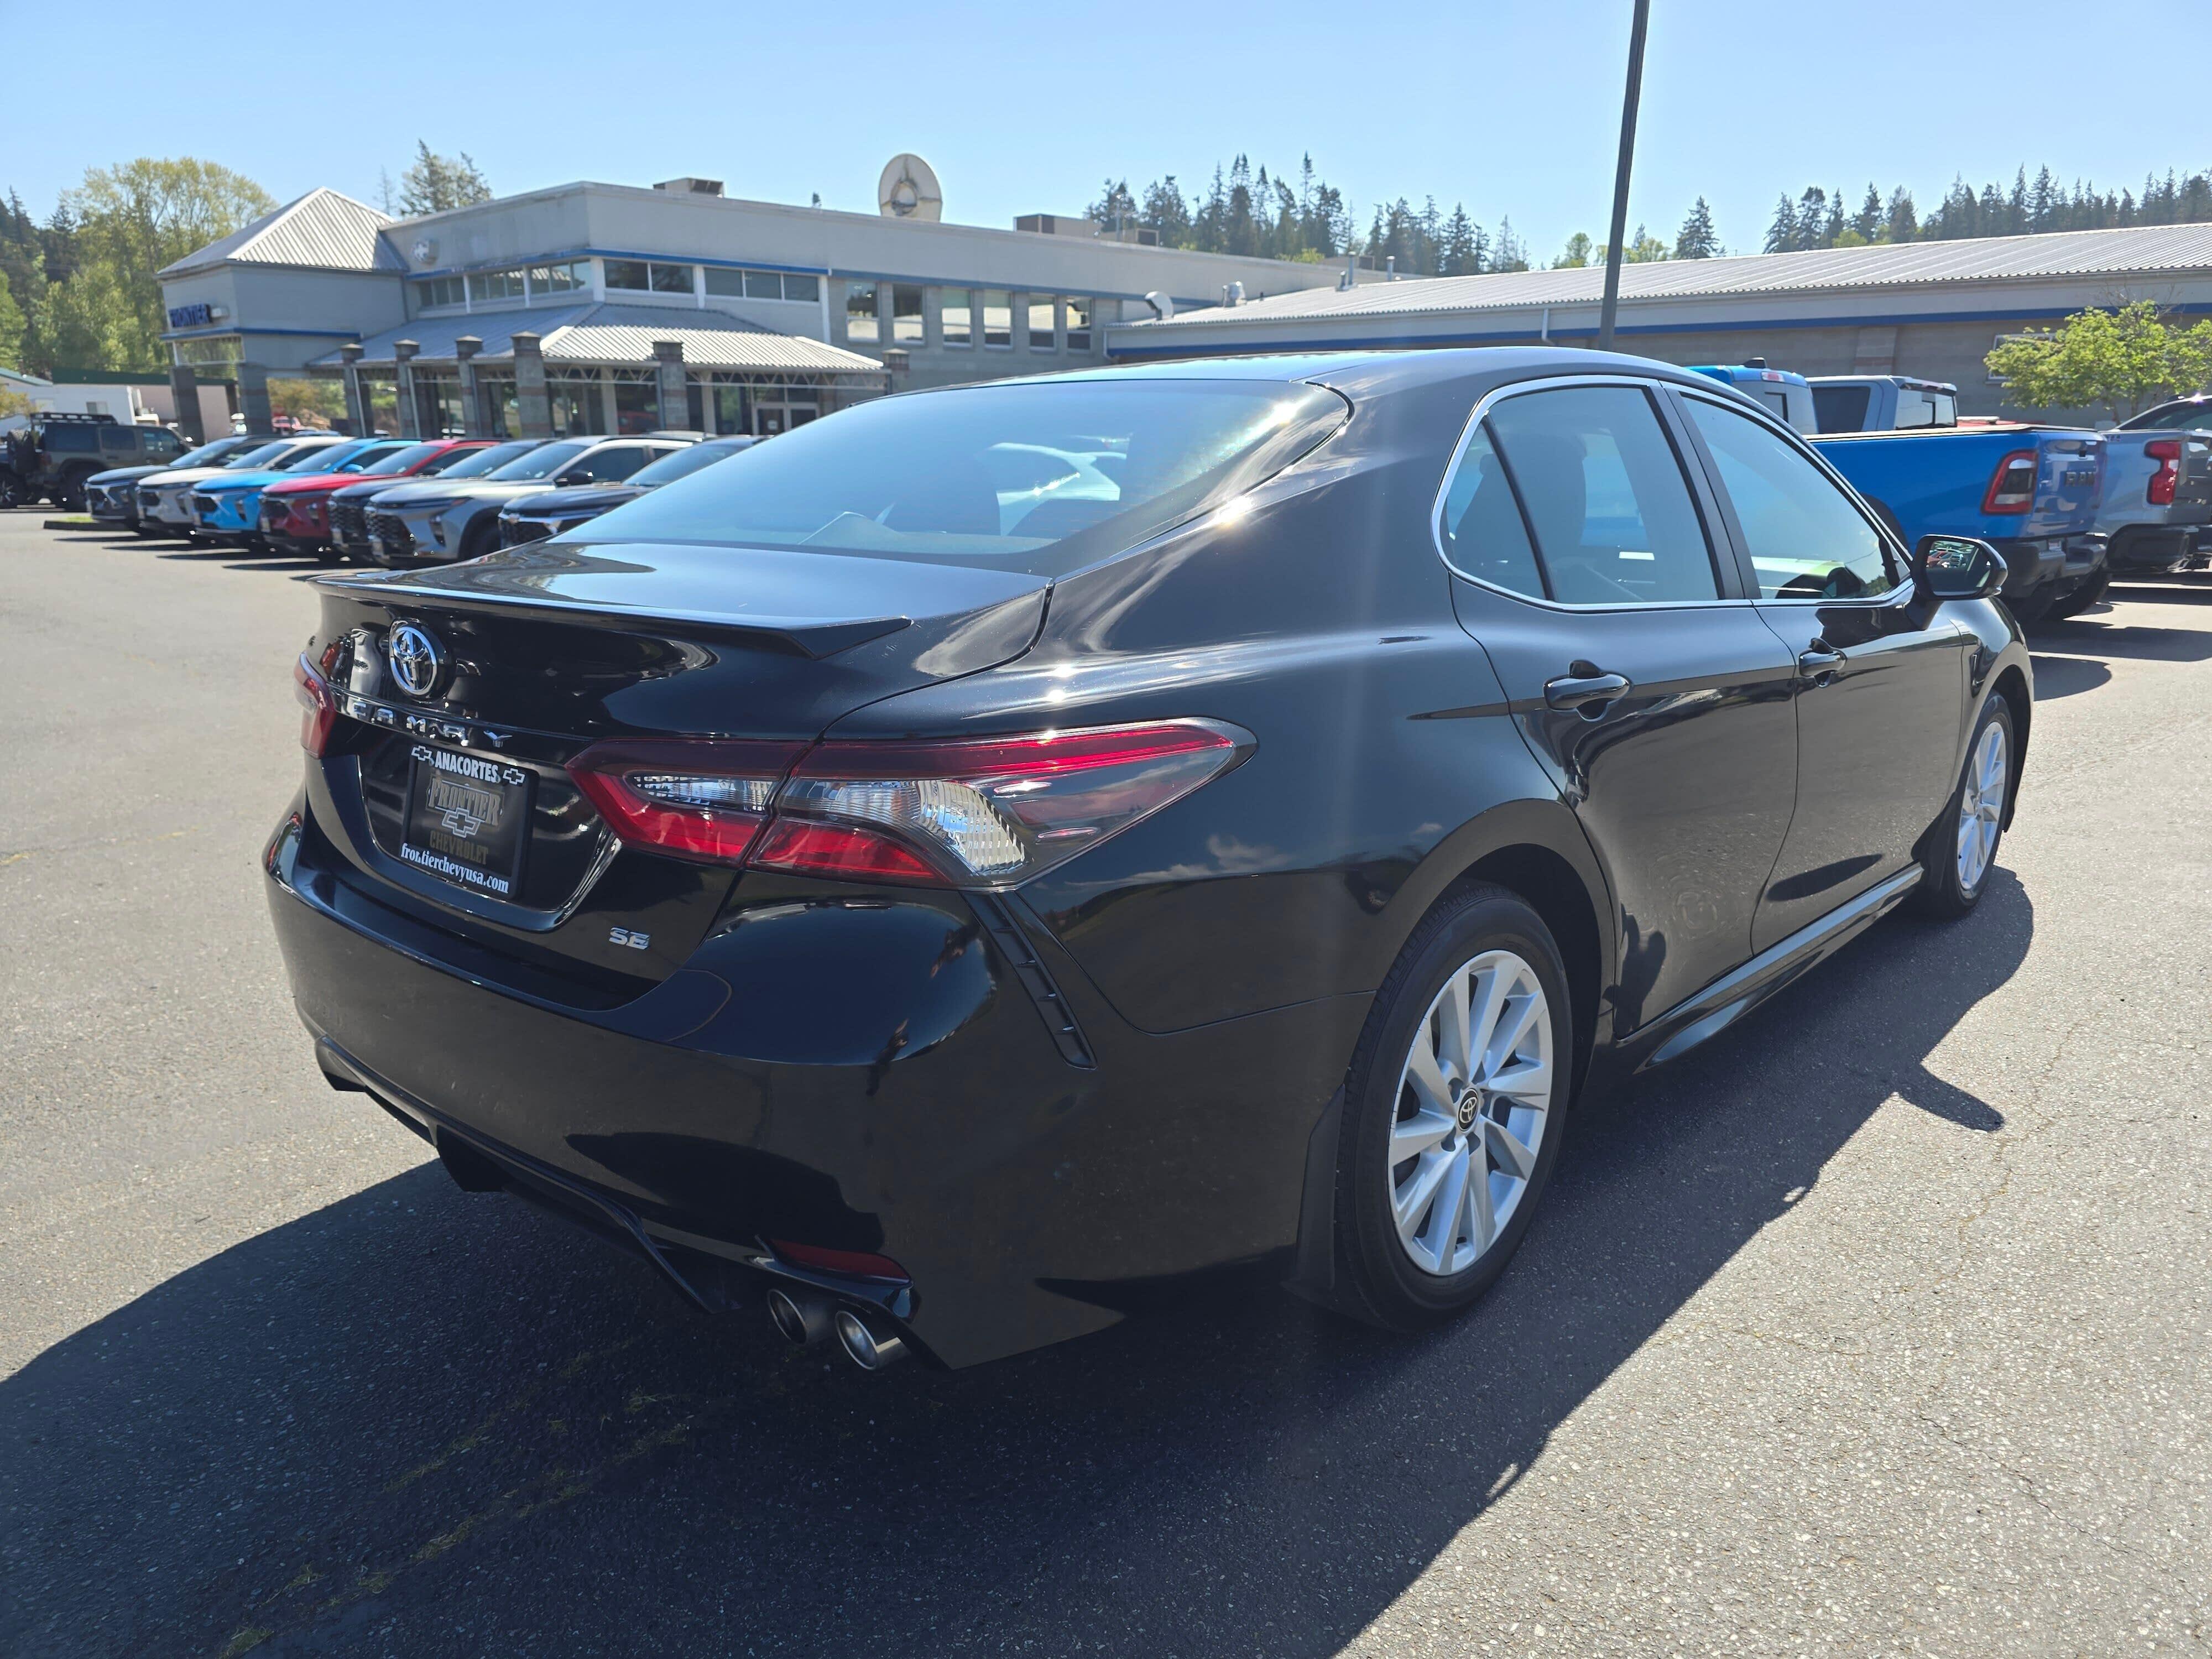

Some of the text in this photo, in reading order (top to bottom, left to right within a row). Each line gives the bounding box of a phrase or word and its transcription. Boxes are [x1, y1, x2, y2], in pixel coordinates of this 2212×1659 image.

[353, 701, 513, 748] CAMRY
[435, 750, 499, 783] ANACORTES
[428, 778, 501, 826] FRONTIER
[400, 842, 509, 894] frontierchevyusa.com
[429, 830, 489, 865] CHEVROLET
[609, 927, 650, 950] SE
